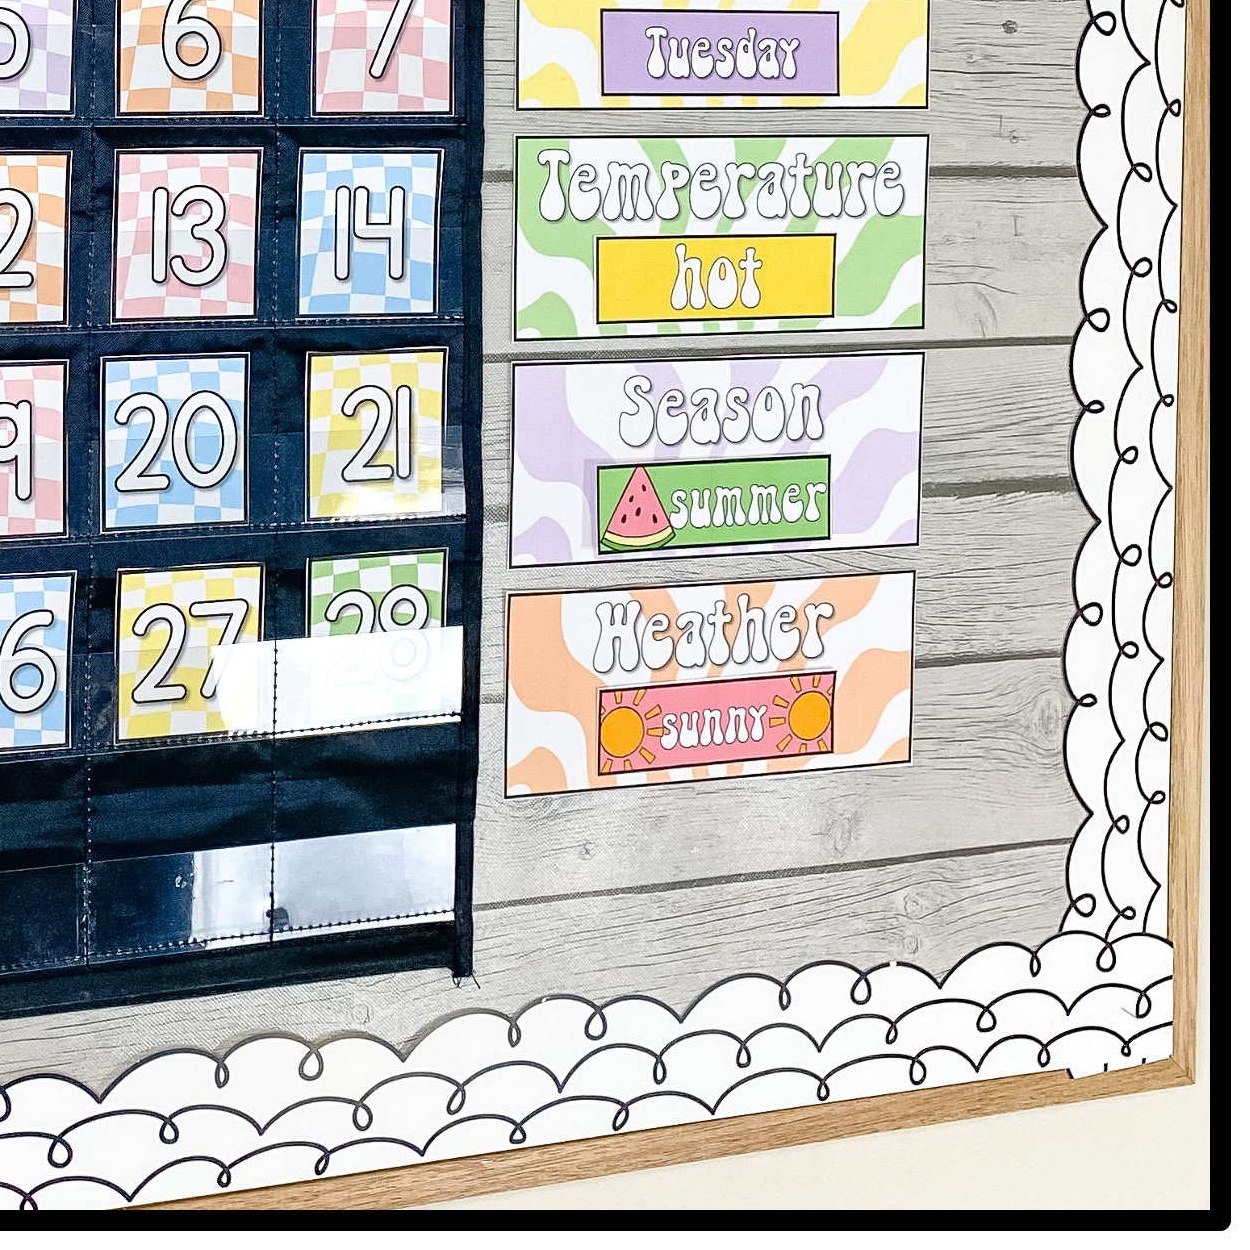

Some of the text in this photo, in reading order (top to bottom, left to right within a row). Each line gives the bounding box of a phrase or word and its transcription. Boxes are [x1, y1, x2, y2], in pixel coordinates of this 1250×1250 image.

[644, 26, 801, 80] Tuesday
[537, 148, 906, 221] Temperature
[150, 183, 229, 288] 13
[333, 183, 406, 282] 14
[670, 244, 763, 310] hot
[113, 389, 240, 492] 20
[339, 384, 412, 482] 21
[618, 374, 824, 447] Season
[668, 478, 827, 529] summer
[593, 593, 834, 674] Weather
[660, 703, 767, 749] sunny
